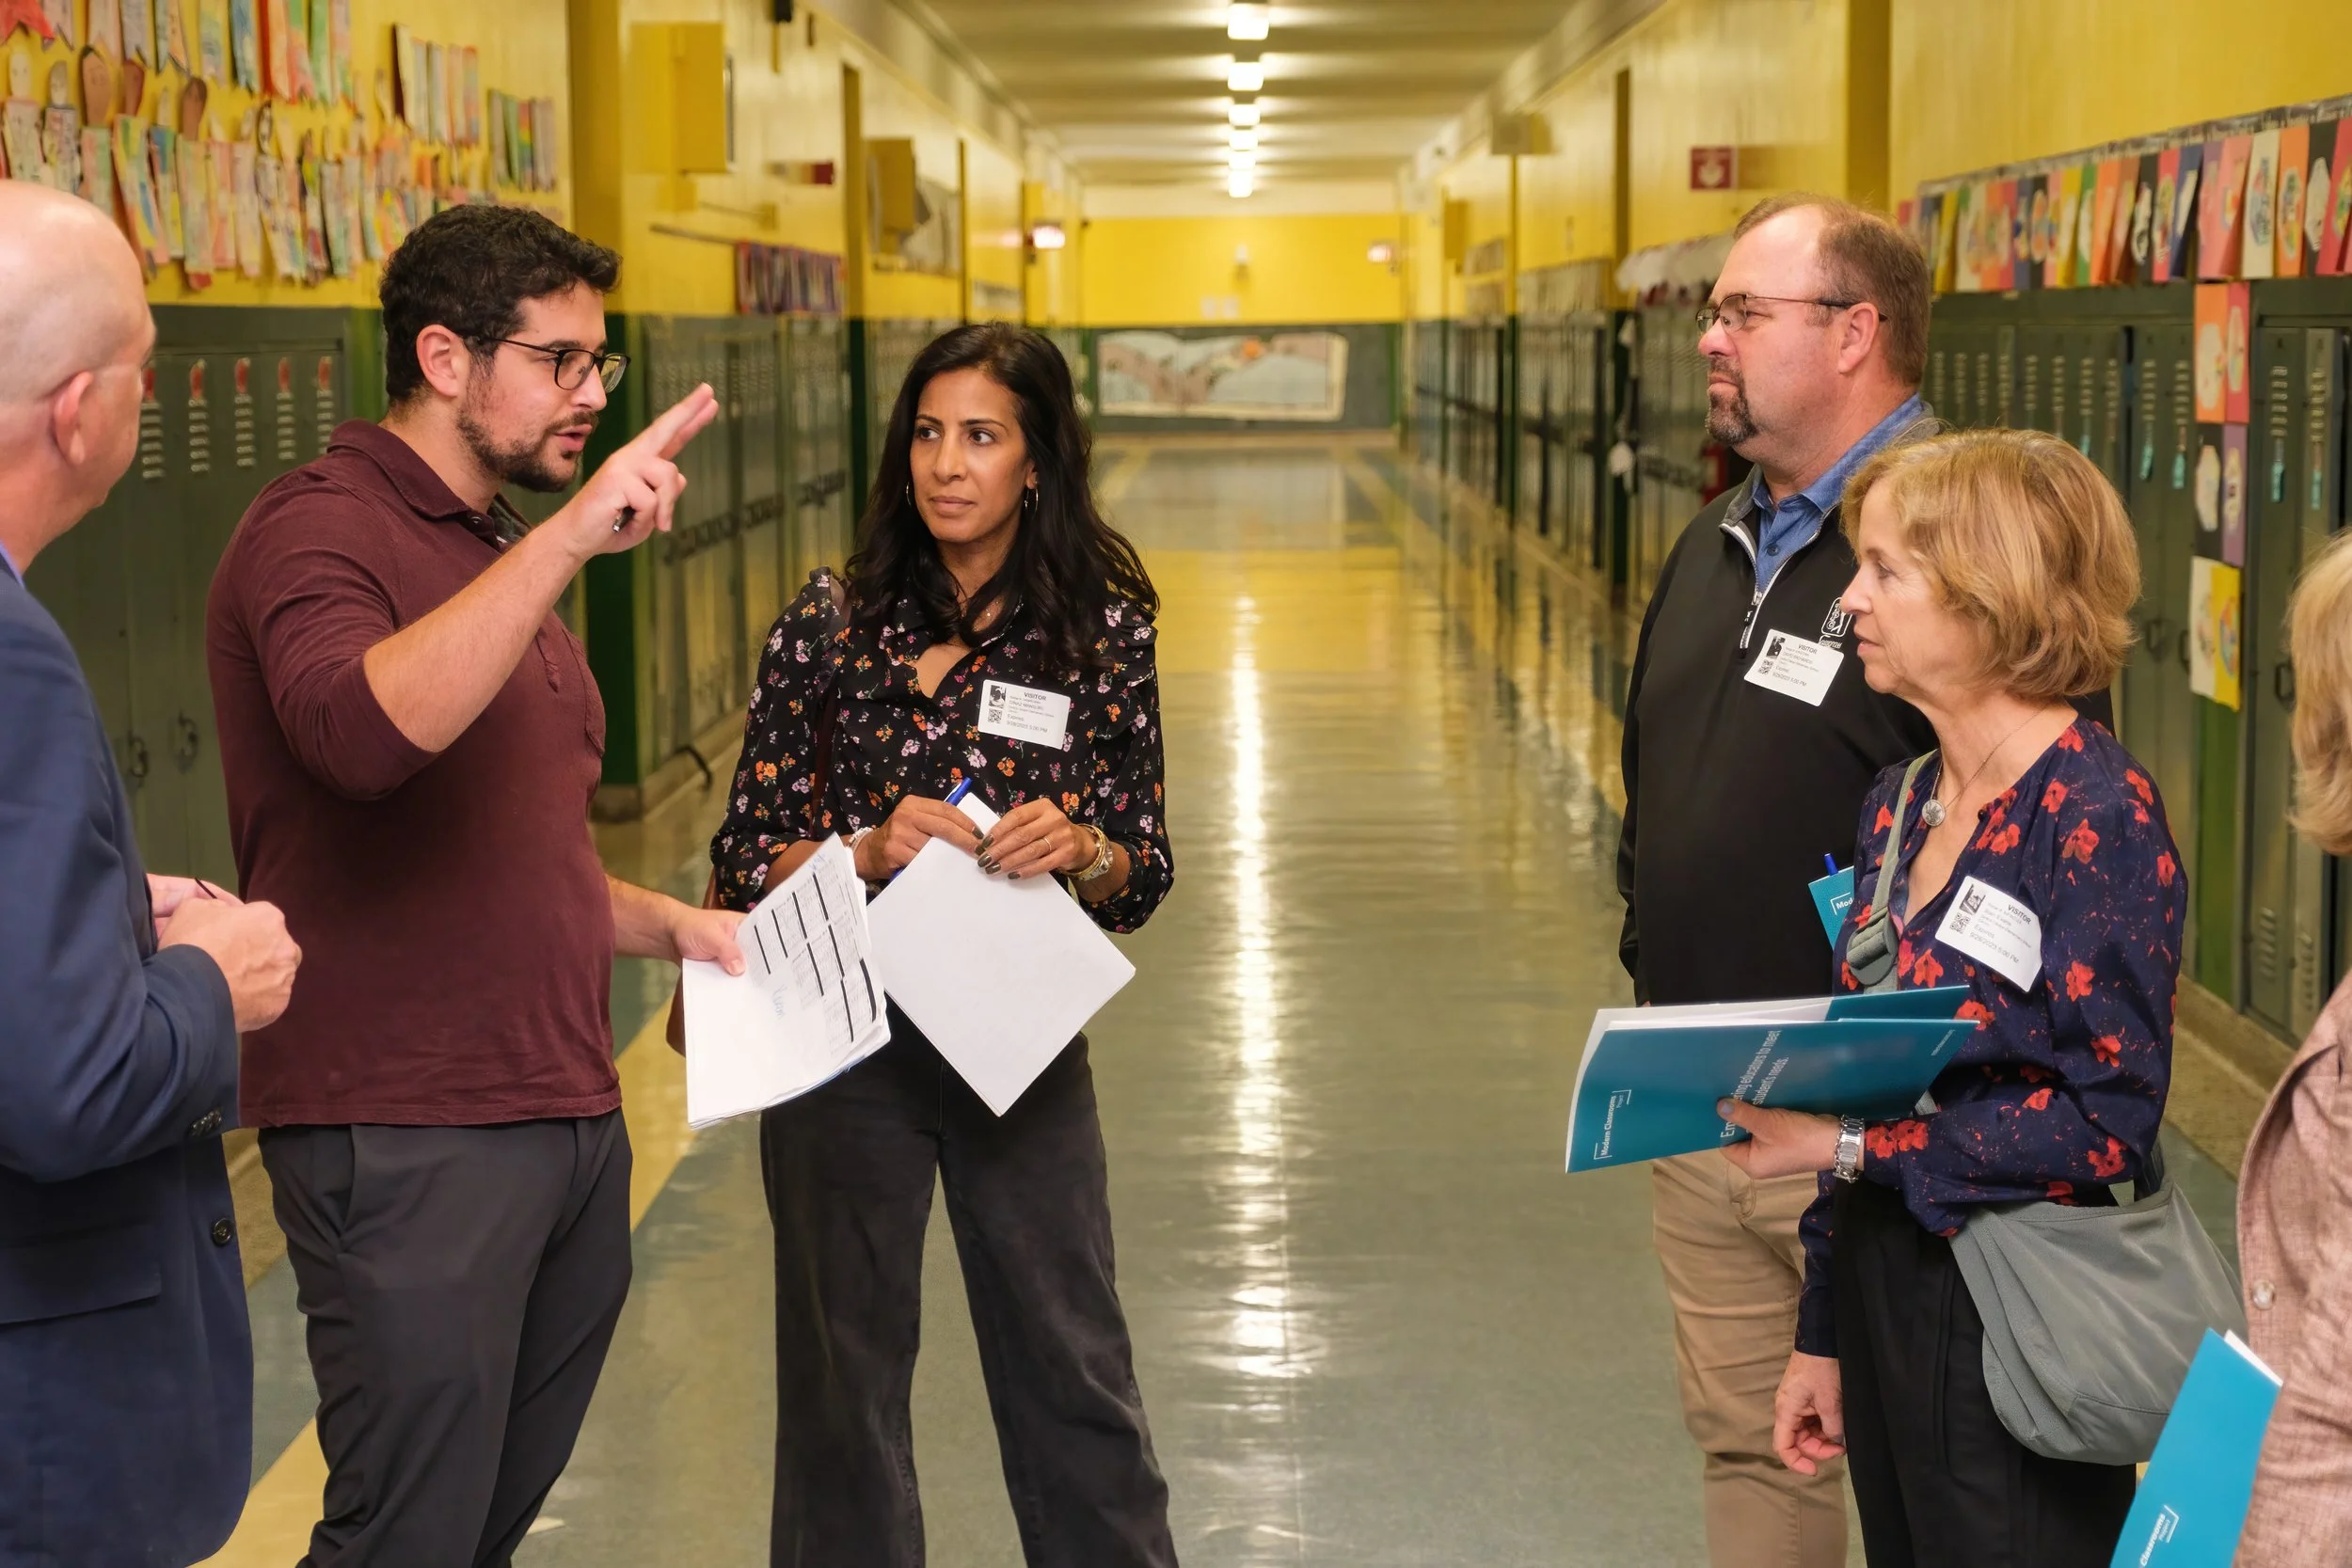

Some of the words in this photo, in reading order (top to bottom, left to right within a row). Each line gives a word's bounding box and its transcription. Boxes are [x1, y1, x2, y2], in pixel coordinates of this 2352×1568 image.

[1799, 643, 1818, 654] VISITOR
[1024, 691, 1047, 701] VISITOR
[2008, 904, 2031, 926] VISITOR
[1762, 1030, 1783, 1047] meet
[1604, 1095, 1617, 1130] Classrooms
[1599, 1131, 1611, 1157] Modern
[2139, 1513, 2166, 1567] Classrooms
